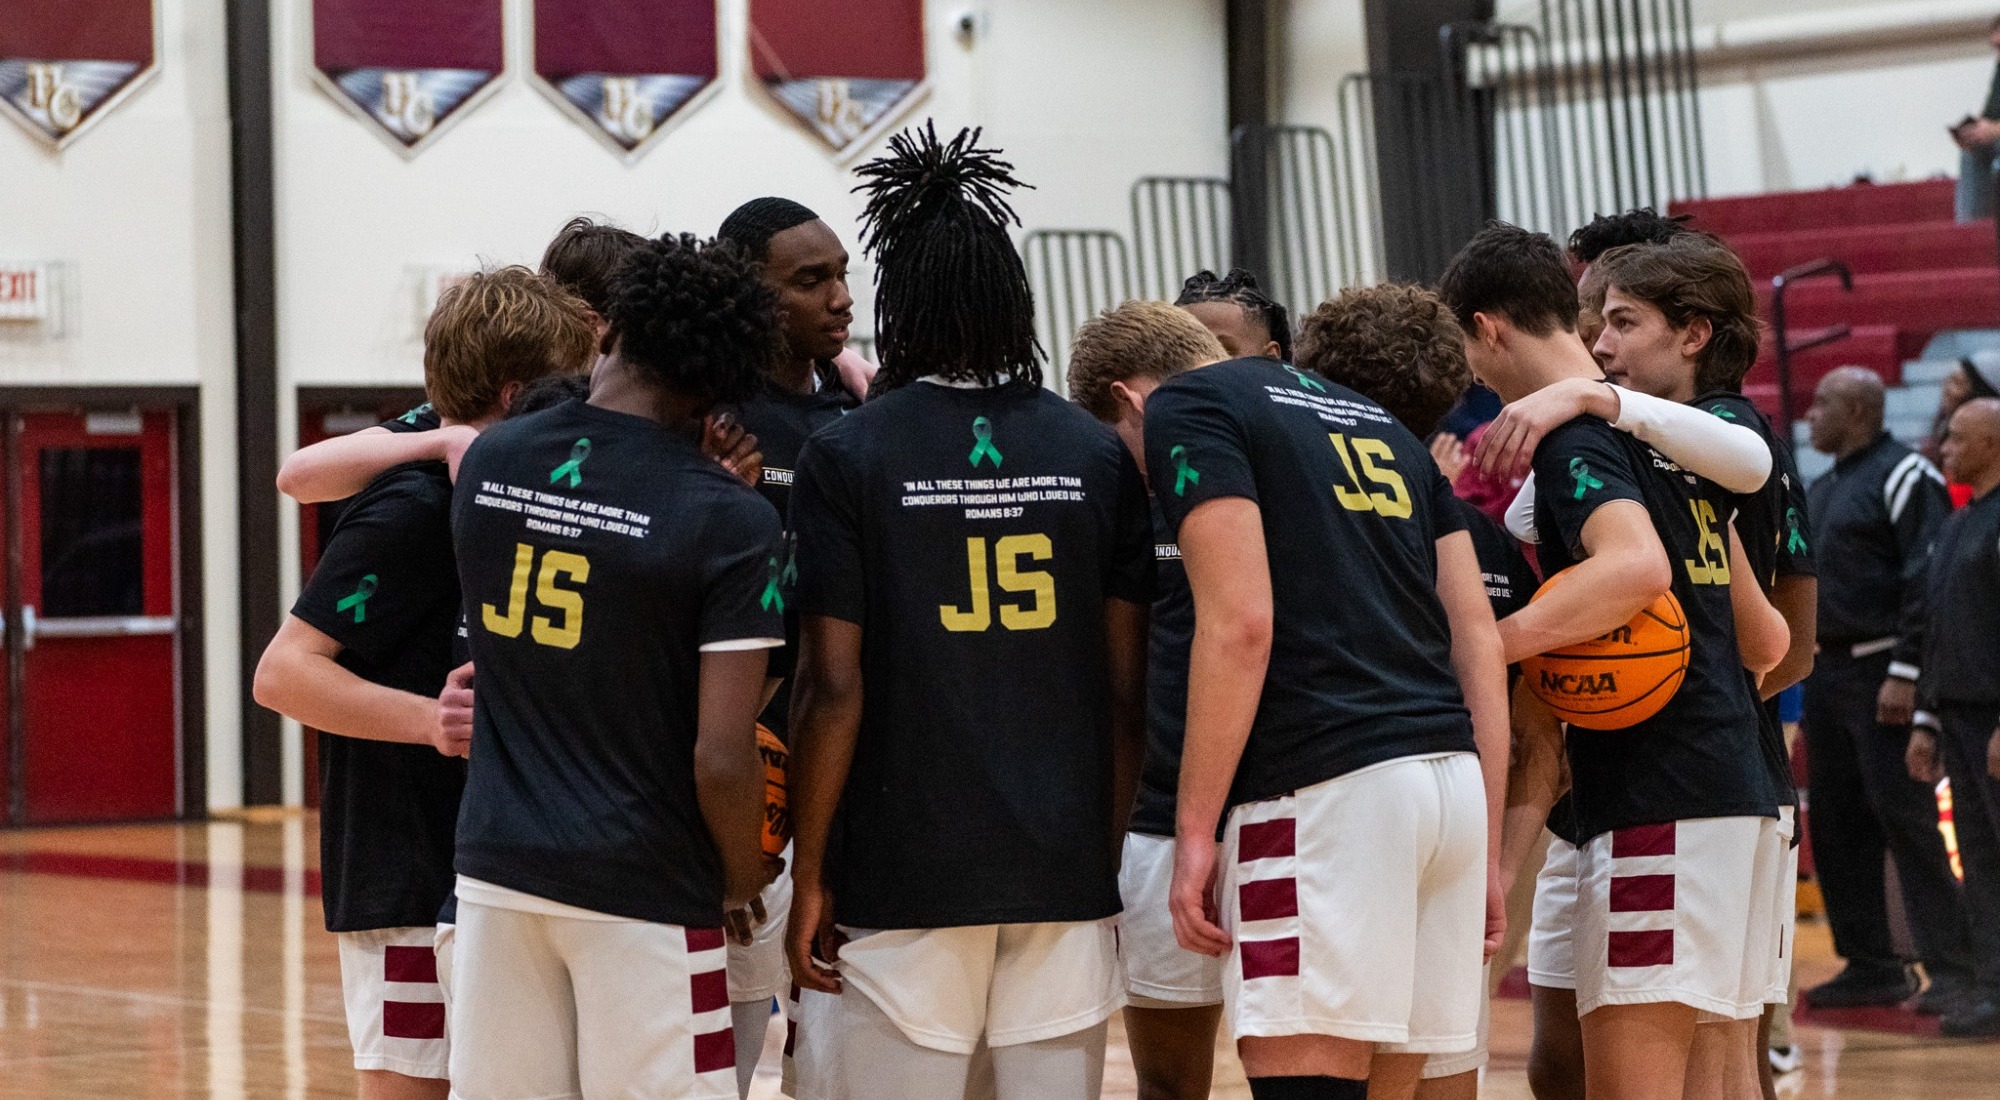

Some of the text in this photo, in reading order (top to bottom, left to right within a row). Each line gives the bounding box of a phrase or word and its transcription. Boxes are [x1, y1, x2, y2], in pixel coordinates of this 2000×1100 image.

[764, 470, 794, 483] CONQU
[917, 481, 935, 491] ALL
[935, 479, 963, 490] THESE
[964, 479, 995, 490] THINGS
[996, 478, 1011, 489] WE
[1012, 477, 1031, 488] ARE
[1031, 476, 1058, 487] MORE
[1059, 476, 1082, 488] THAN
[1328, 433, 1412, 519] JS
[489, 483, 505, 494] ALL
[507, 485, 533, 501] THESE
[535, 491, 565, 506] THINGS
[565, 499, 579, 509] WE
[579, 501, 598, 514] ARE
[598, 505, 623, 519] MORE
[625, 510, 651, 526] THAN
[902, 493, 958, 506] CONQUERORS
[959, 493, 997, 504] THROUGH
[998, 493, 1017, 503] HIM
[1017, 491, 1038, 502] WHO
[1040, 490, 1069, 501] LOVED
[474, 494, 523, 513] CONQUERORS
[524, 503, 562, 520] THROUGH
[562, 512, 580, 524] HIM
[580, 516, 600, 528] WHO
[600, 520, 629, 535] LOVED
[965, 506, 1024, 519] ROMANS 8:37
[526, 518, 582, 538] ROMANS 8:37
[1685, 499, 1730, 584] JS
[940, 533, 1056, 632] JS
[1493, 574, 1509, 584] THAN
[482, 543, 590, 649] JS
[1540, 670, 1618, 695] NCAA
